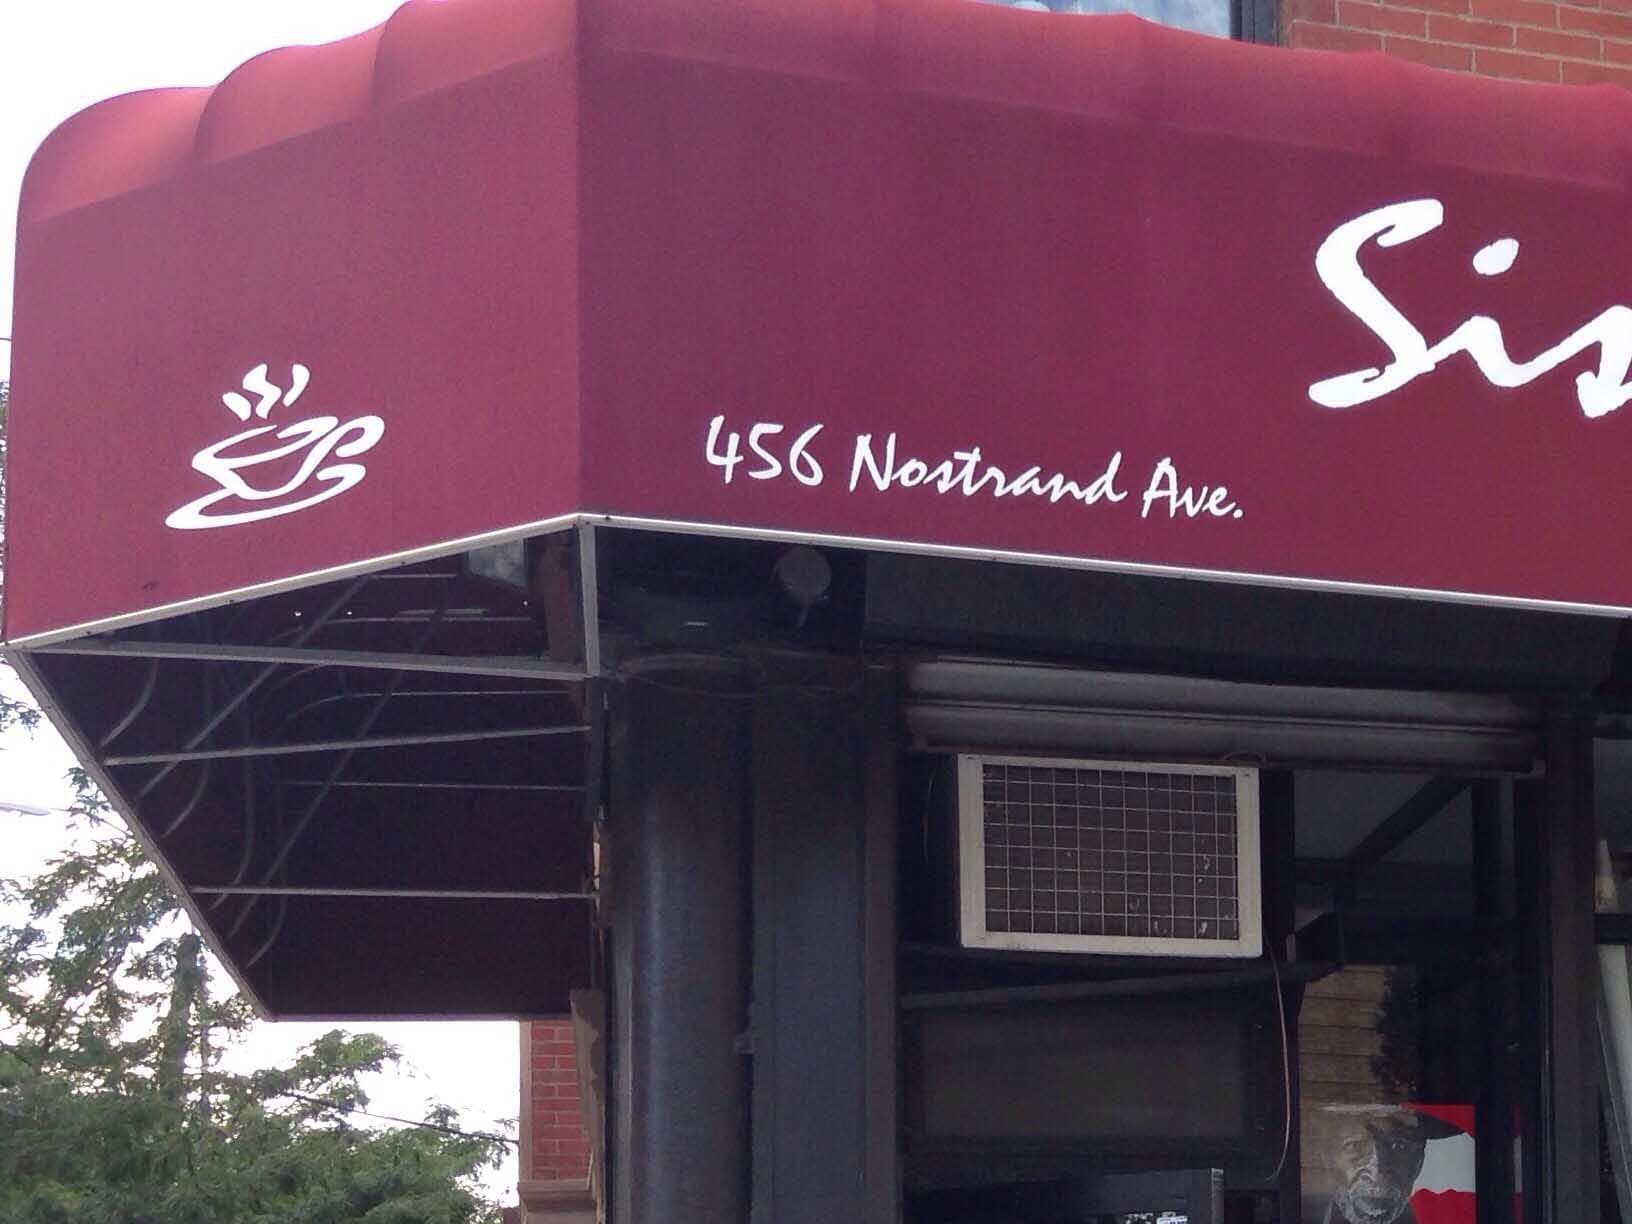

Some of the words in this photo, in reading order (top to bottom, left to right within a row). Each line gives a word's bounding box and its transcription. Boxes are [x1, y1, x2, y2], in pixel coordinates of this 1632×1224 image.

[705, 415, 825, 486] 456
[848, 432, 1129, 505] Nostrand
[1141, 456, 1245, 519] Ave.
